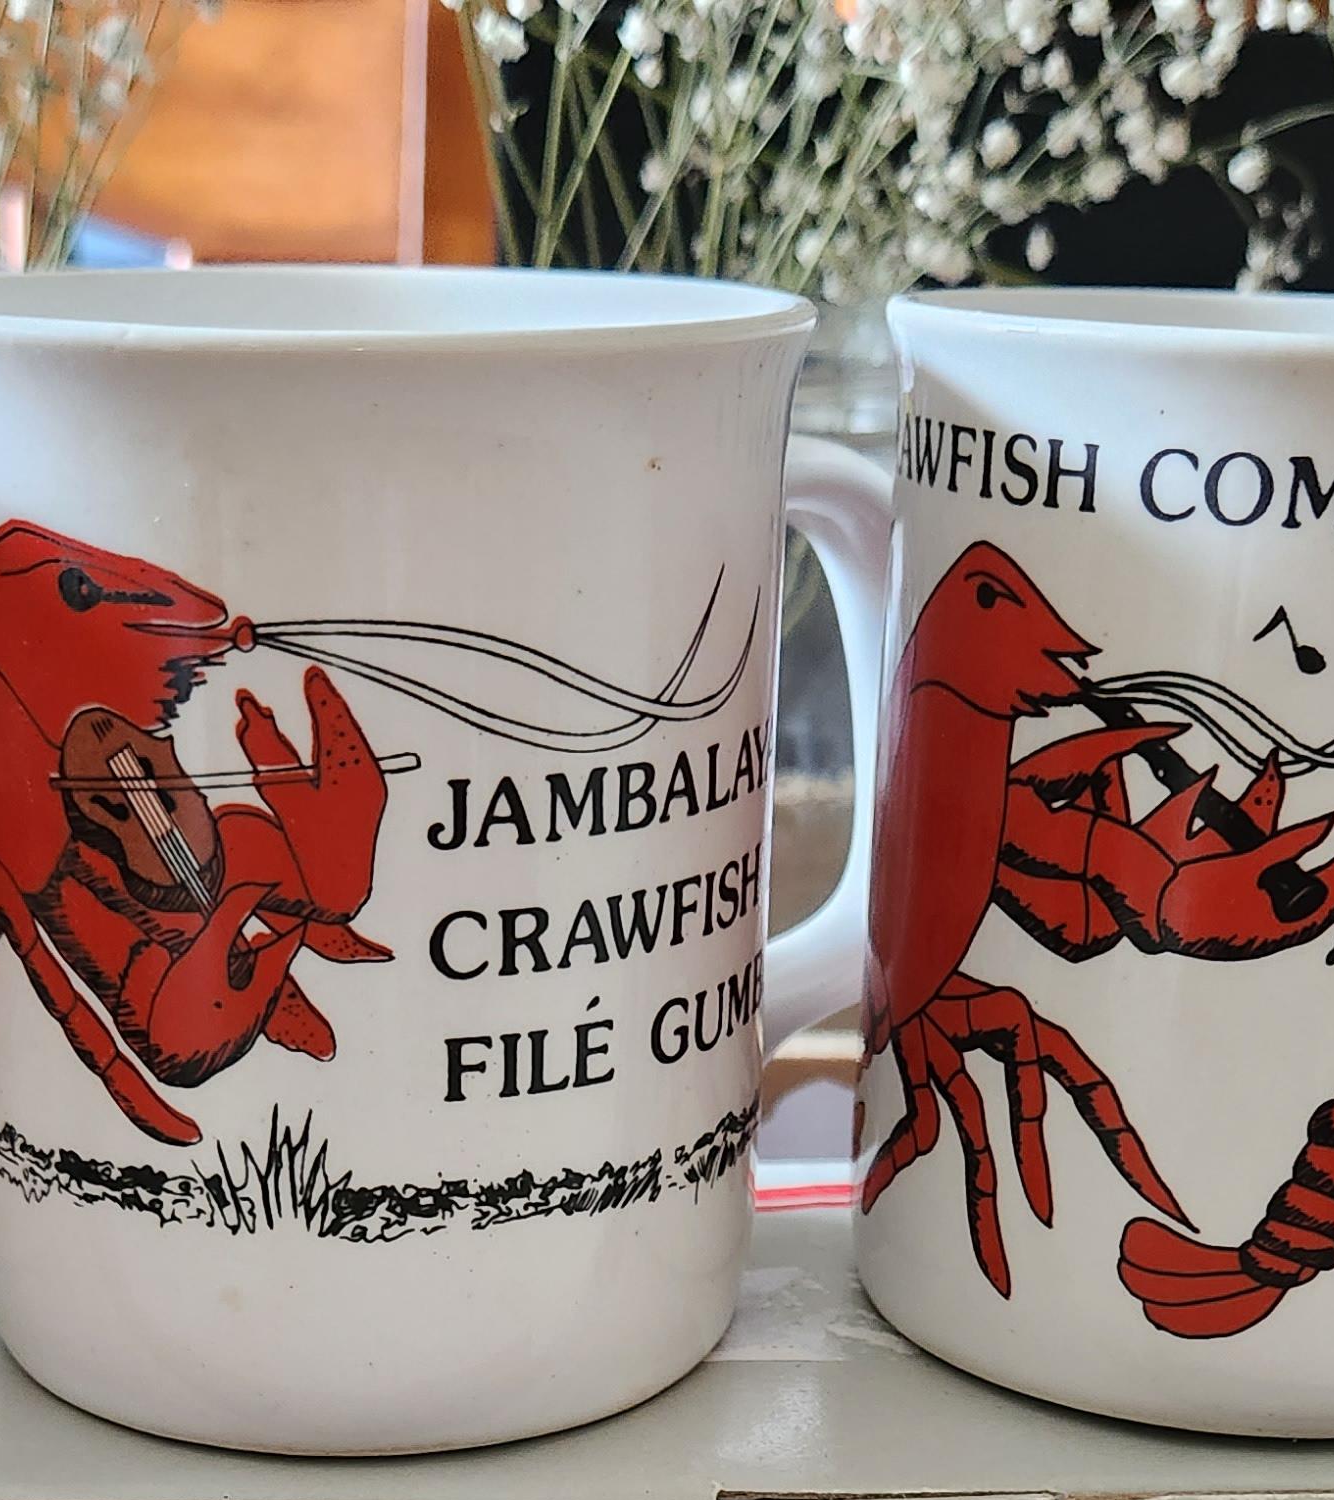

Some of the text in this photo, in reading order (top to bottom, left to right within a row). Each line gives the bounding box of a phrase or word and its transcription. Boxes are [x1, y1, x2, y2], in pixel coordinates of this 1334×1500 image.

[898, 412, 1100, 514] AWFISH
[427, 714, 773, 851] JAMBALAY
[429, 843, 761, 981] CRAWFISH
[443, 995, 615, 1102] FILÉ
